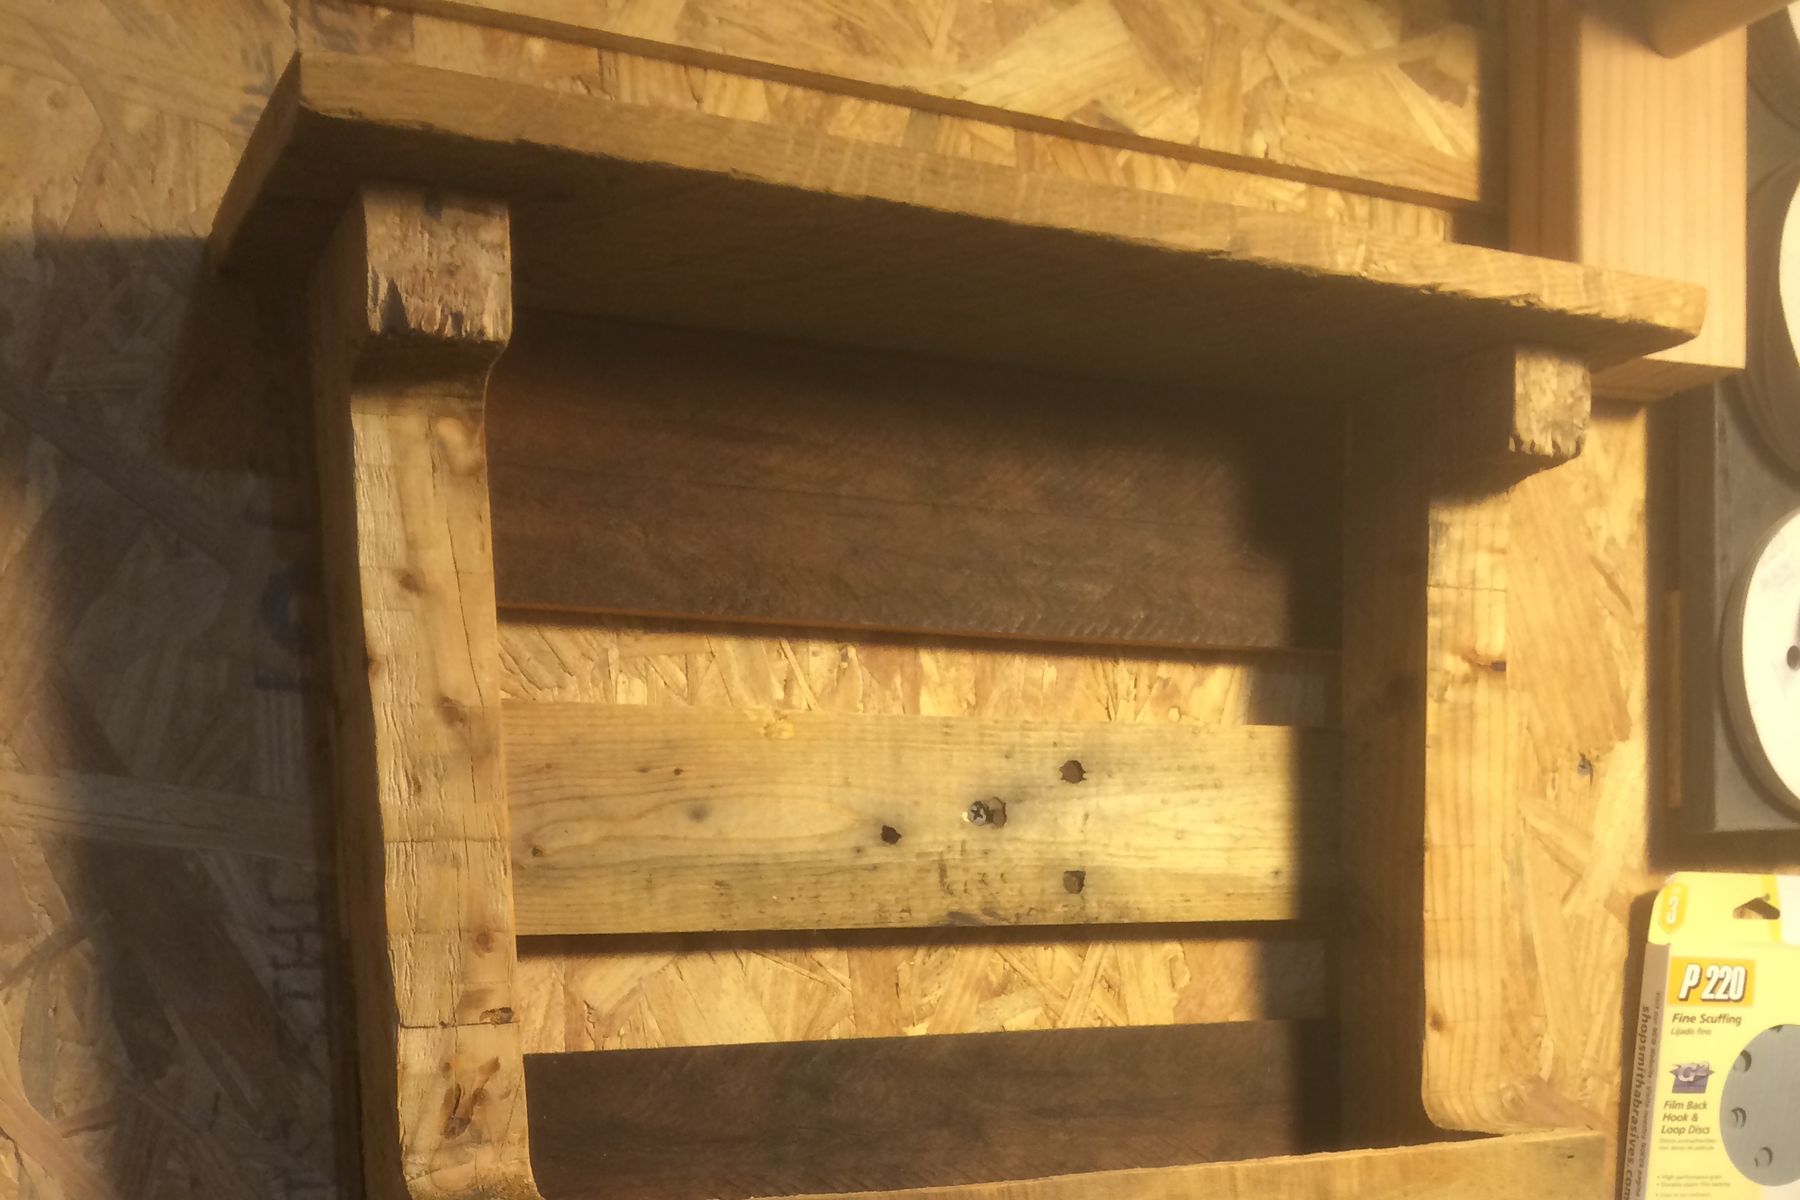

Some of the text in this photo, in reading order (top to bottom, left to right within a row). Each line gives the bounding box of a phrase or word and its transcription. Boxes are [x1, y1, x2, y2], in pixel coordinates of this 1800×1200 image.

[1678, 963, 1748, 1003] P 220
[1672, 1013, 1742, 1027] Fine Scuffing
[1663, 1100, 1708, 1110] Film Back
[1662, 1112, 1699, 1122] Hook &
[1661, 1125, 1711, 1136] Loop Discs
